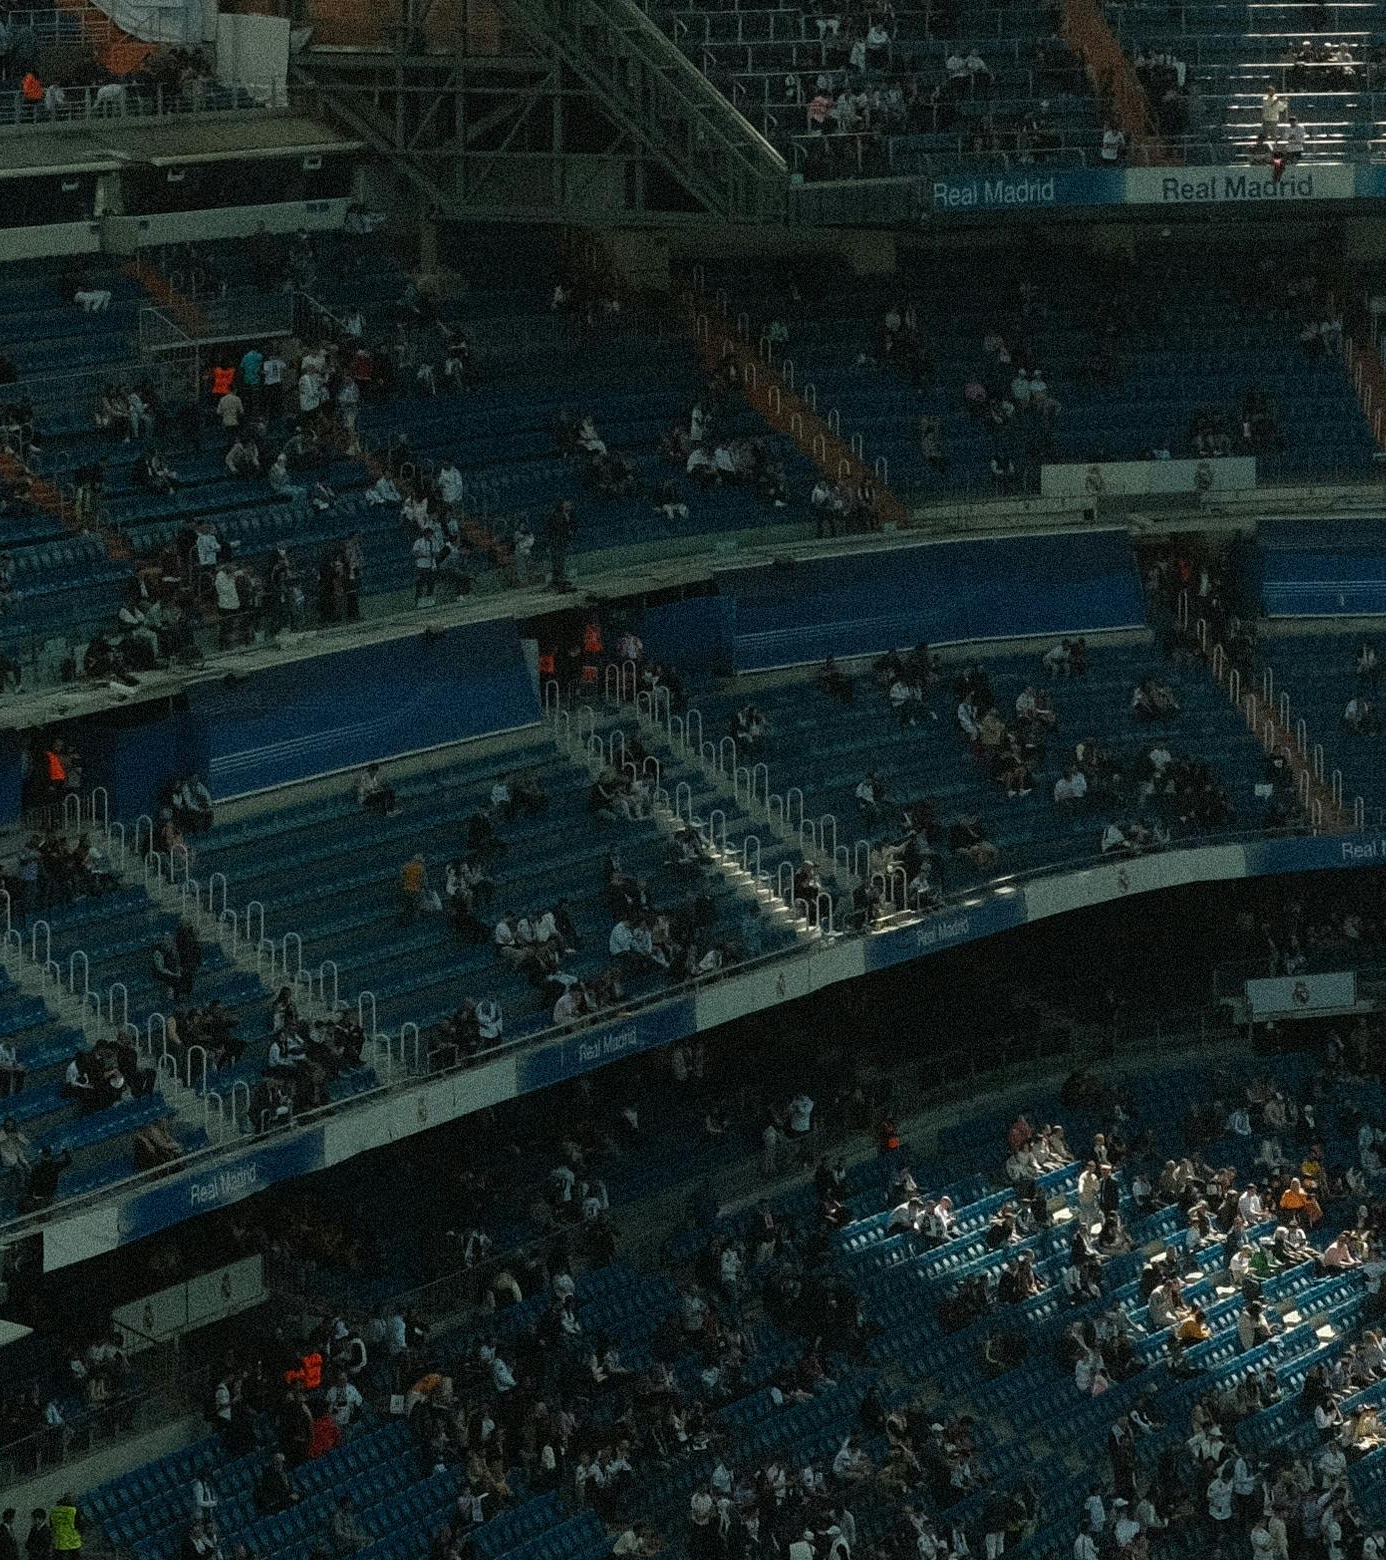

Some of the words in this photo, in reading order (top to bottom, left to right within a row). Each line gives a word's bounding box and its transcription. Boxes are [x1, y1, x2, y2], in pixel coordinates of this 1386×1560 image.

[933, 182, 977, 206] Real
[984, 178, 1054, 203] Madrid
[1163, 177, 1215, 199] Real
[1225, 174, 1312, 198] Madrid
[1341, 840, 1377, 860] Real
